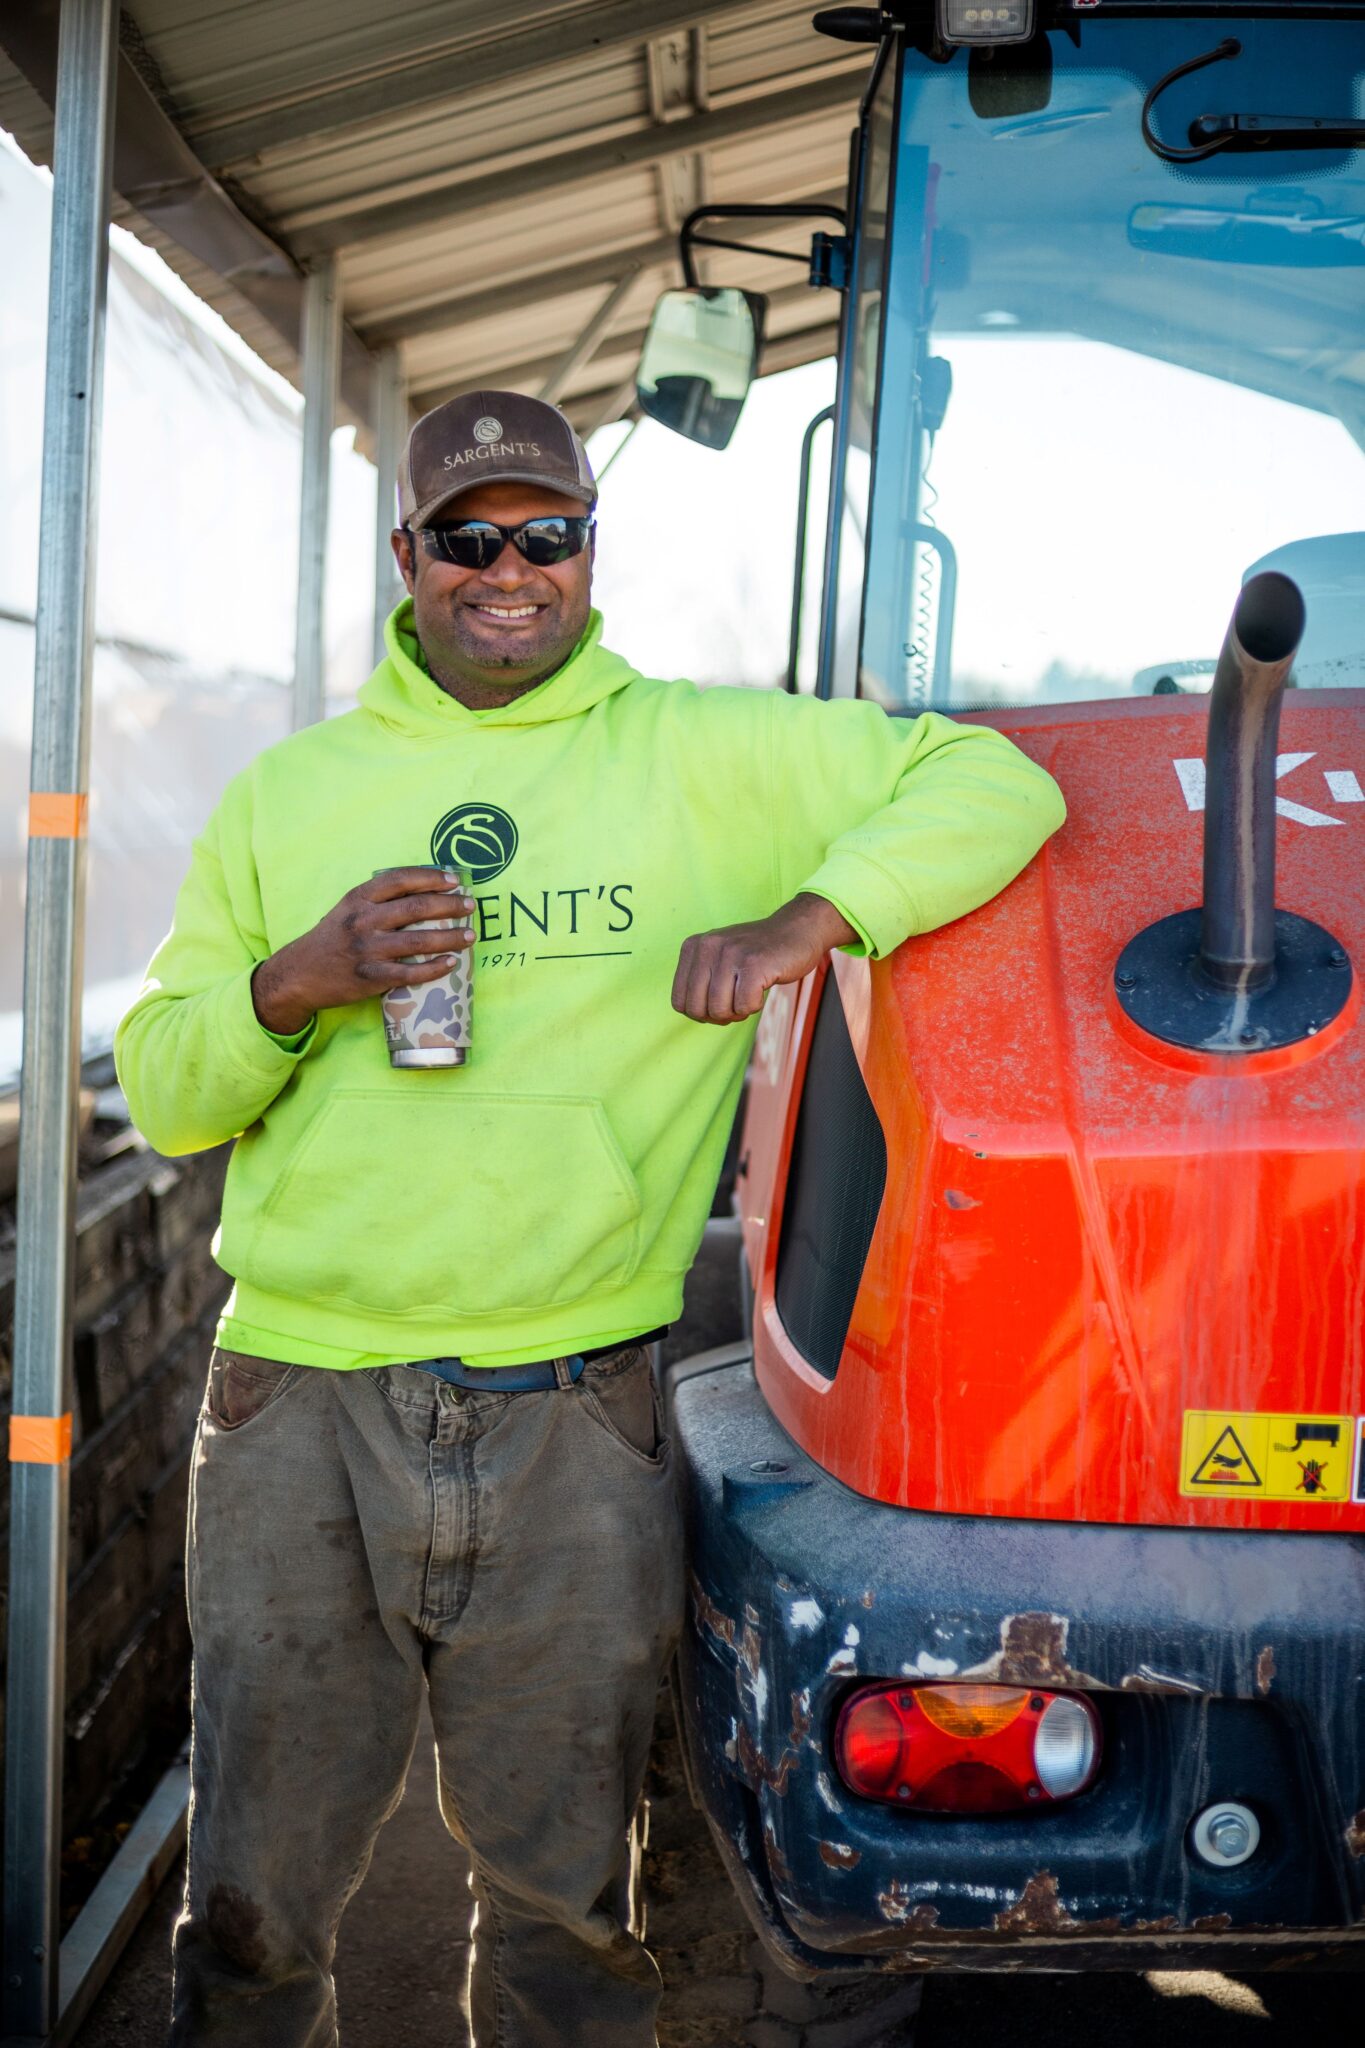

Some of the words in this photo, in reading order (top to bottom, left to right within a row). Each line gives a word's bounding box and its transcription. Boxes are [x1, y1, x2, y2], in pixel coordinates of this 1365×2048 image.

[444, 442, 541, 471] SARGENT'S
[475, 884, 634, 943] ENT'S
[481, 952, 526, 968] 1971
